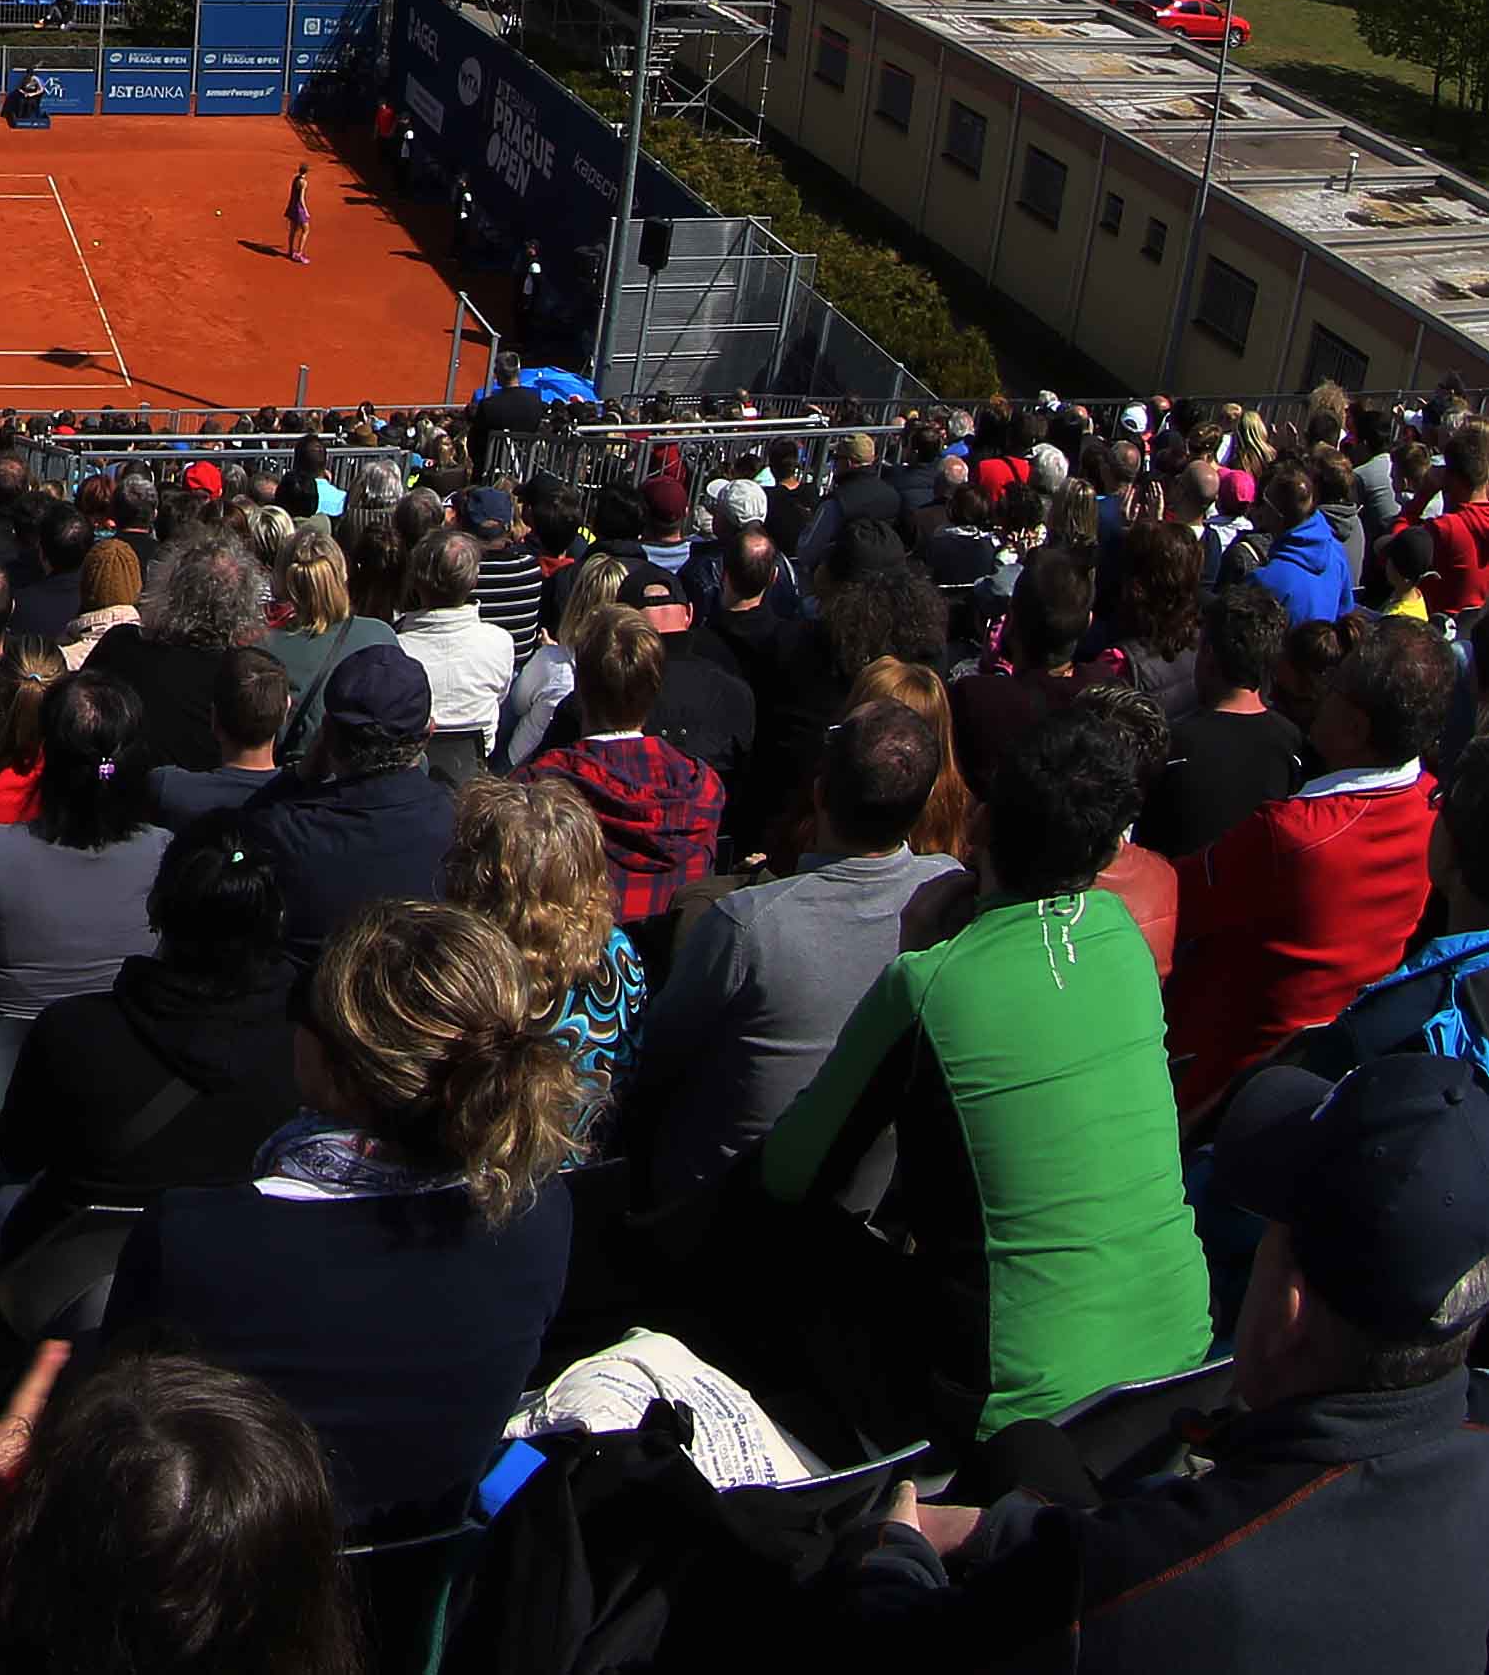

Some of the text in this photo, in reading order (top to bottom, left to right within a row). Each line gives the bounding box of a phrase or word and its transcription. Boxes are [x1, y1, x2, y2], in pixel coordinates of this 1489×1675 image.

[412, 16, 439, 62] AGEL
[127, 53, 187, 65] PRAGUE OPEN
[222, 53, 280, 65] PRAGUE OPEN
[108, 85, 184, 99] J&T BANKA
[205, 86, 266, 99] smartwings
[493, 97, 556, 180] PRAGUE
[487, 131, 532, 197] OPEN
[573, 151, 619, 202] kapsch
